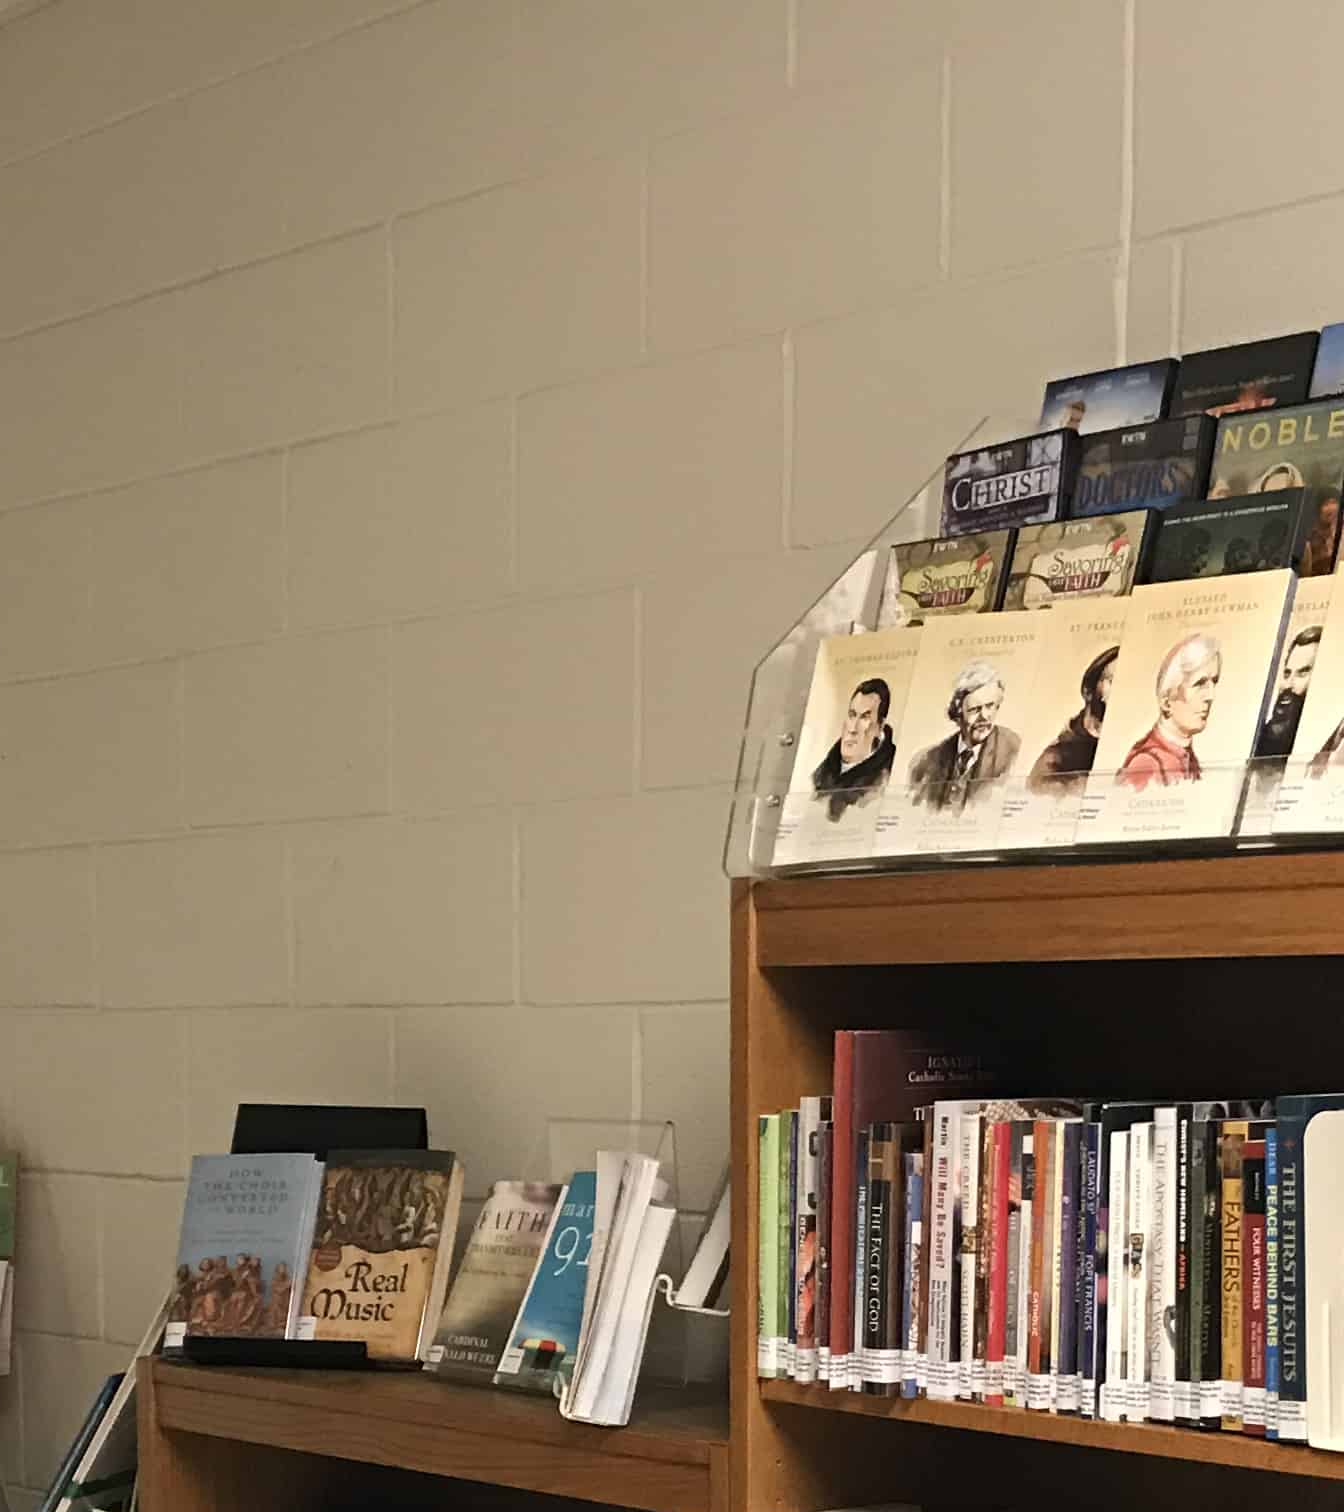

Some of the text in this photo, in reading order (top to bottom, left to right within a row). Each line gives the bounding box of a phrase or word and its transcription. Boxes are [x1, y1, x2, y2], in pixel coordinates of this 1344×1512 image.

[952, 465, 1052, 511] CHRIST
[919, 567, 988, 592] Savoring
[1048, 551, 1124, 577] Savoring
[1063, 573, 1102, 592] FAITH
[939, 1116, 950, 1146] Martin
[228, 1168, 263, 1178] HOW
[937, 1157, 948, 1179] Will
[1155, 1143, 1167, 1171] THE
[204, 1180, 287, 1191] THE CHOIR
[1086, 1150, 1097, 1200] LAUDATO
[1178, 1165, 1187, 1187] NEW
[225, 1205, 278, 1215] WORLD
[935, 1182, 947, 1209] Many
[478, 1210, 546, 1232] FAITH
[870, 1203, 884, 1233] THE
[1152, 1180, 1166, 1255] APOSTASY
[1178, 1189, 1187, 1242] HOMELAND
[869, 1236, 883, 1270] FACE
[935, 1231, 946, 1269] Saved?
[1223, 1200, 1241, 1293] FATHERS
[1251, 1227, 1262, 1256] FOUR
[345, 1261, 408, 1293] Real
[1151, 1260, 1164, 1304] THAT
[1178, 1254, 1187, 1290] AFRICA
[1266, 1185, 1278, 1347] PEACE BEHIND BARS
[1281, 1162, 1297, 1382] THE FIRST JESUITS
[1083, 1254, 1095, 1332] POPE FRANCIS
[1251, 1258, 1262, 1311] WITNESSES
[310, 1288, 394, 1321] Music
[868, 1297, 881, 1332] GOD
[1031, 1291, 1041, 1337] CATHOLIC
